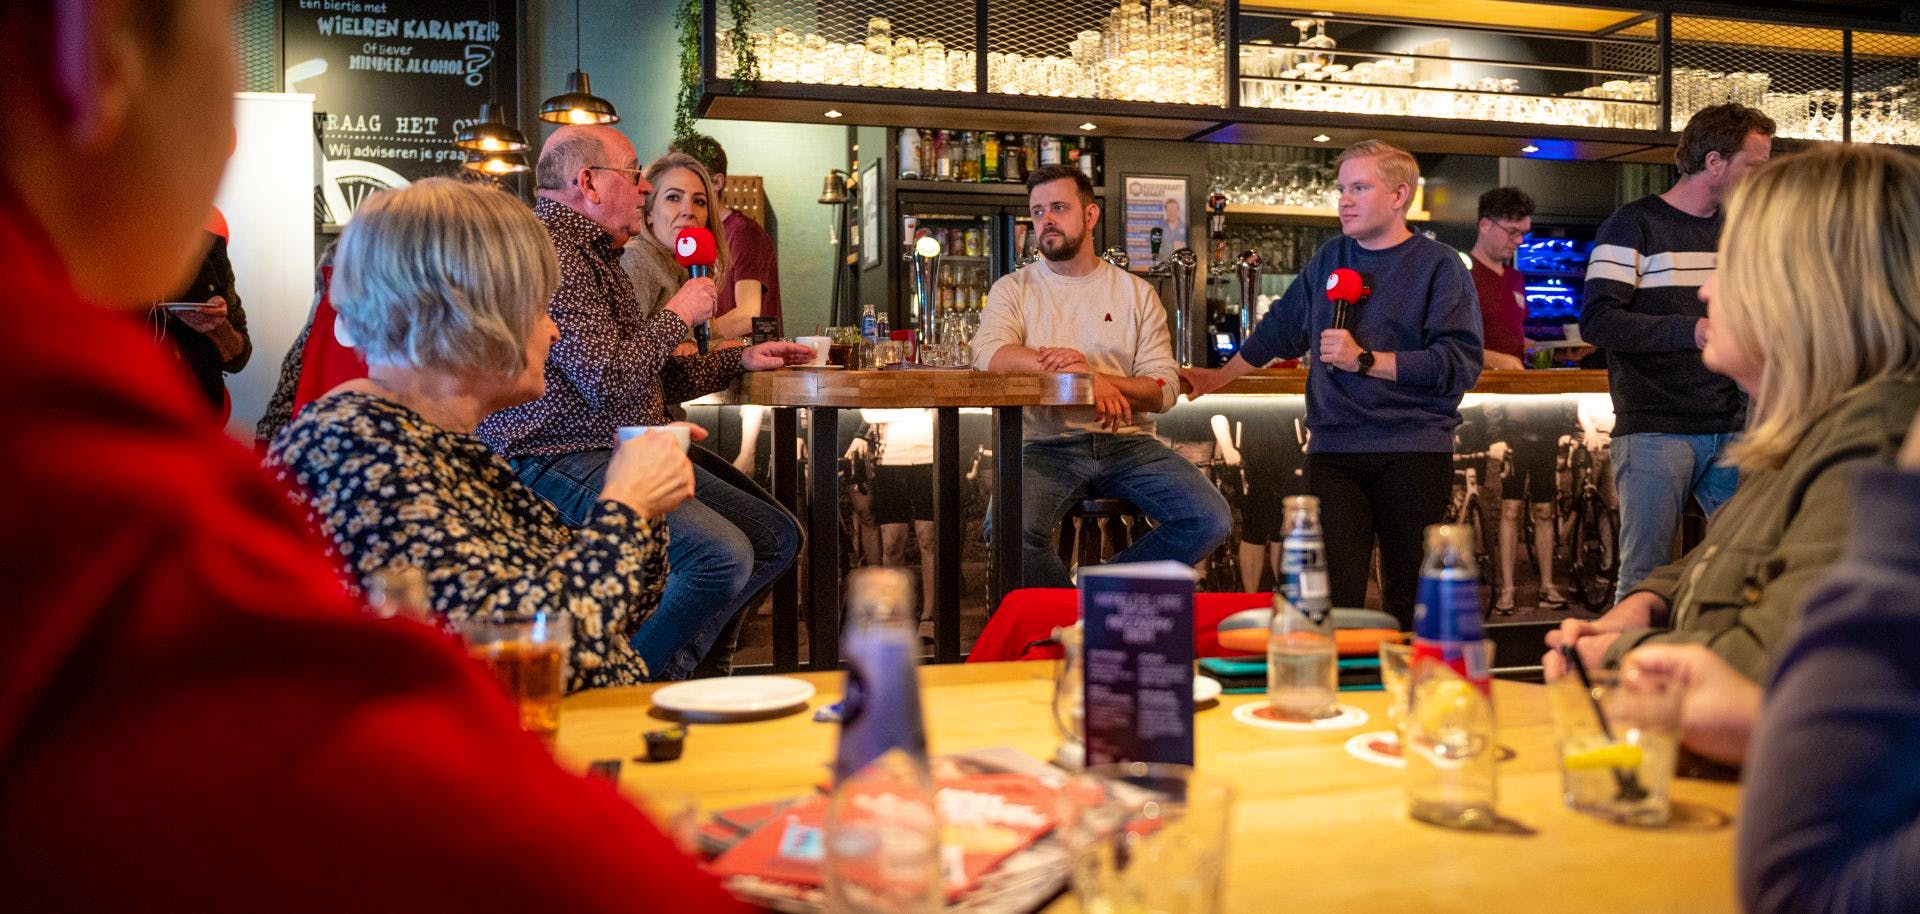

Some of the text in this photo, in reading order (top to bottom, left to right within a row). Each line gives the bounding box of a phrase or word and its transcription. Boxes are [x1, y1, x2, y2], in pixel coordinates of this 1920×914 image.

[300, 0, 388, 13] Een biertje met
[403, 19, 500, 42] KARAKTER
[362, 42, 378, 54] Of
[349, 55, 405, 72] MINDER
[395, 117, 438, 135] HET
[328, 143, 351, 160] Wij
[353, 146, 418, 160] adviseren
[420, 147, 433, 162] je
